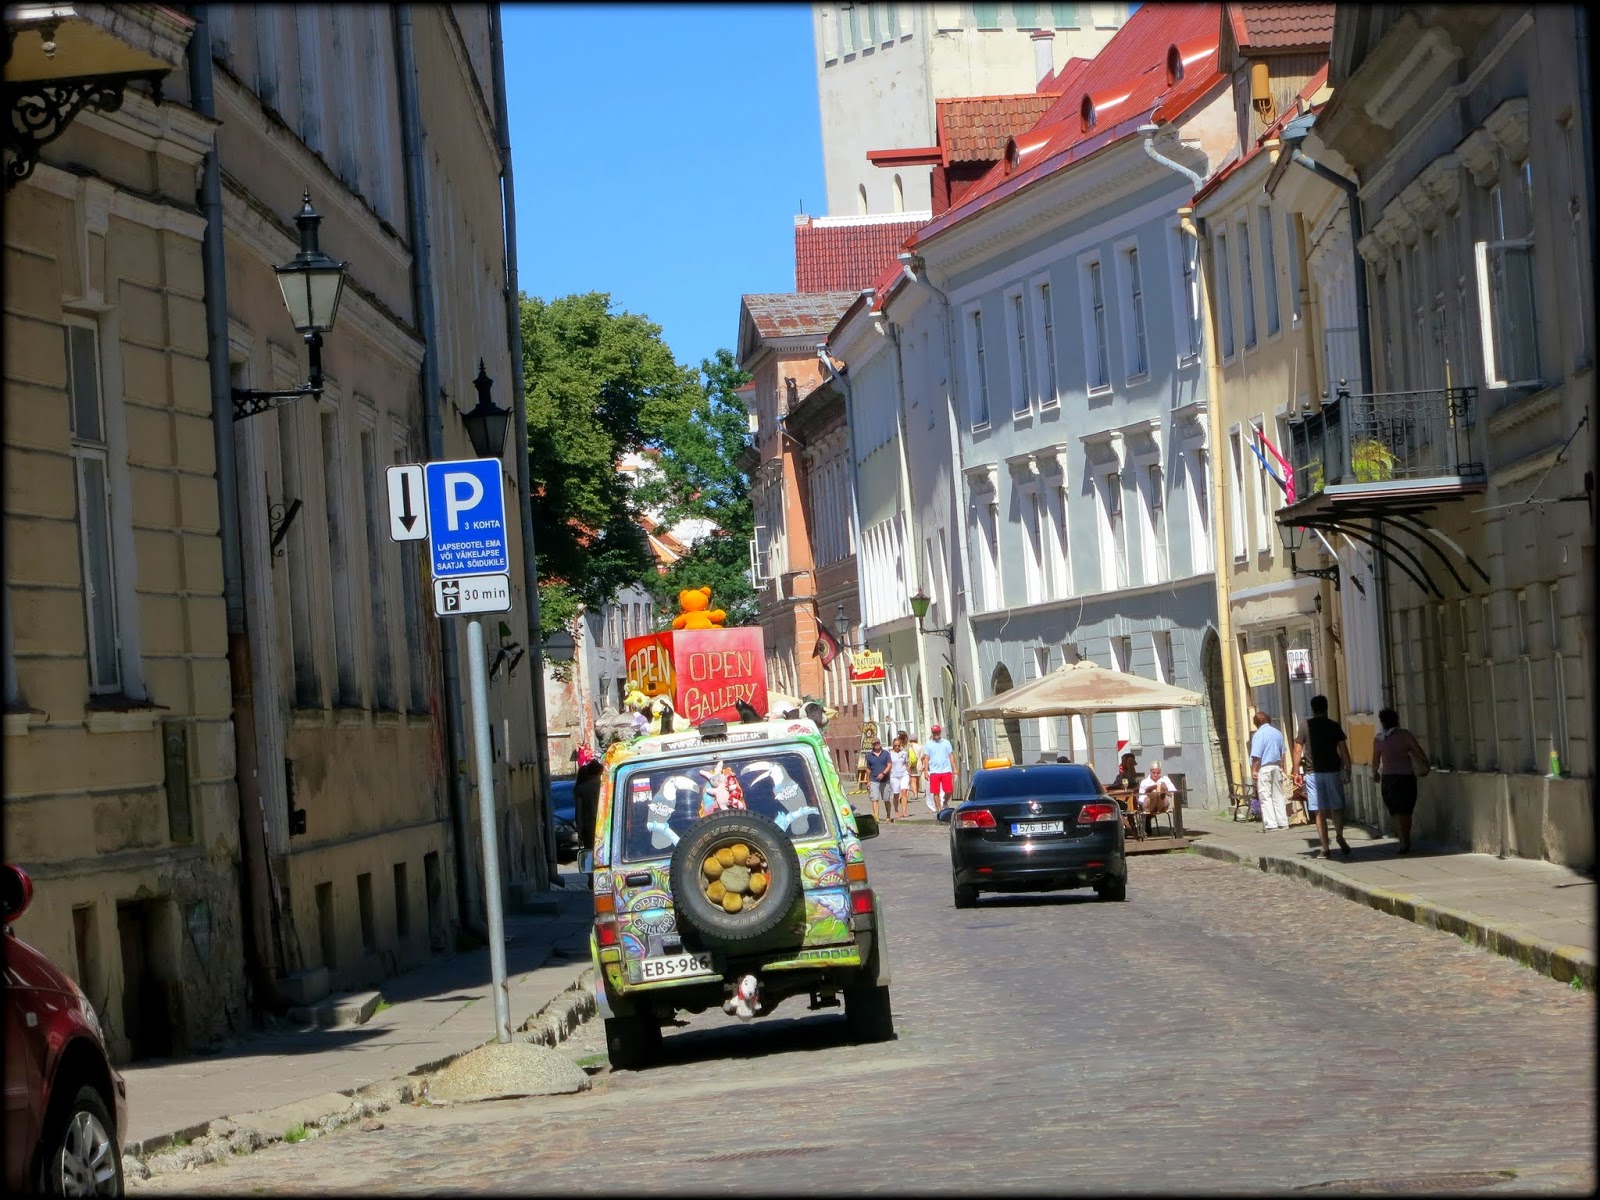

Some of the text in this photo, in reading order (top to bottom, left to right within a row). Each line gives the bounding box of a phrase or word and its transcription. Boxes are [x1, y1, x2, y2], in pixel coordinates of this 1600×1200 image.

[444, 472, 484, 531] P
[464, 520, 501, 530] 3 KOHTA
[437, 539, 501, 552] LAPSEOOTEL EMA
[440, 549, 500, 561] VÕI VÄIKELAPSE
[436, 558, 505, 570] SAATJA SÕIDUKILE
[464, 588, 506, 600] 30 min
[447, 597, 457, 610] P
[628, 645, 671, 689] OPEN
[689, 650, 755, 682] OPEN
[684, 682, 758, 723] GALLERY
[634, 897, 667, 911] OPEN
